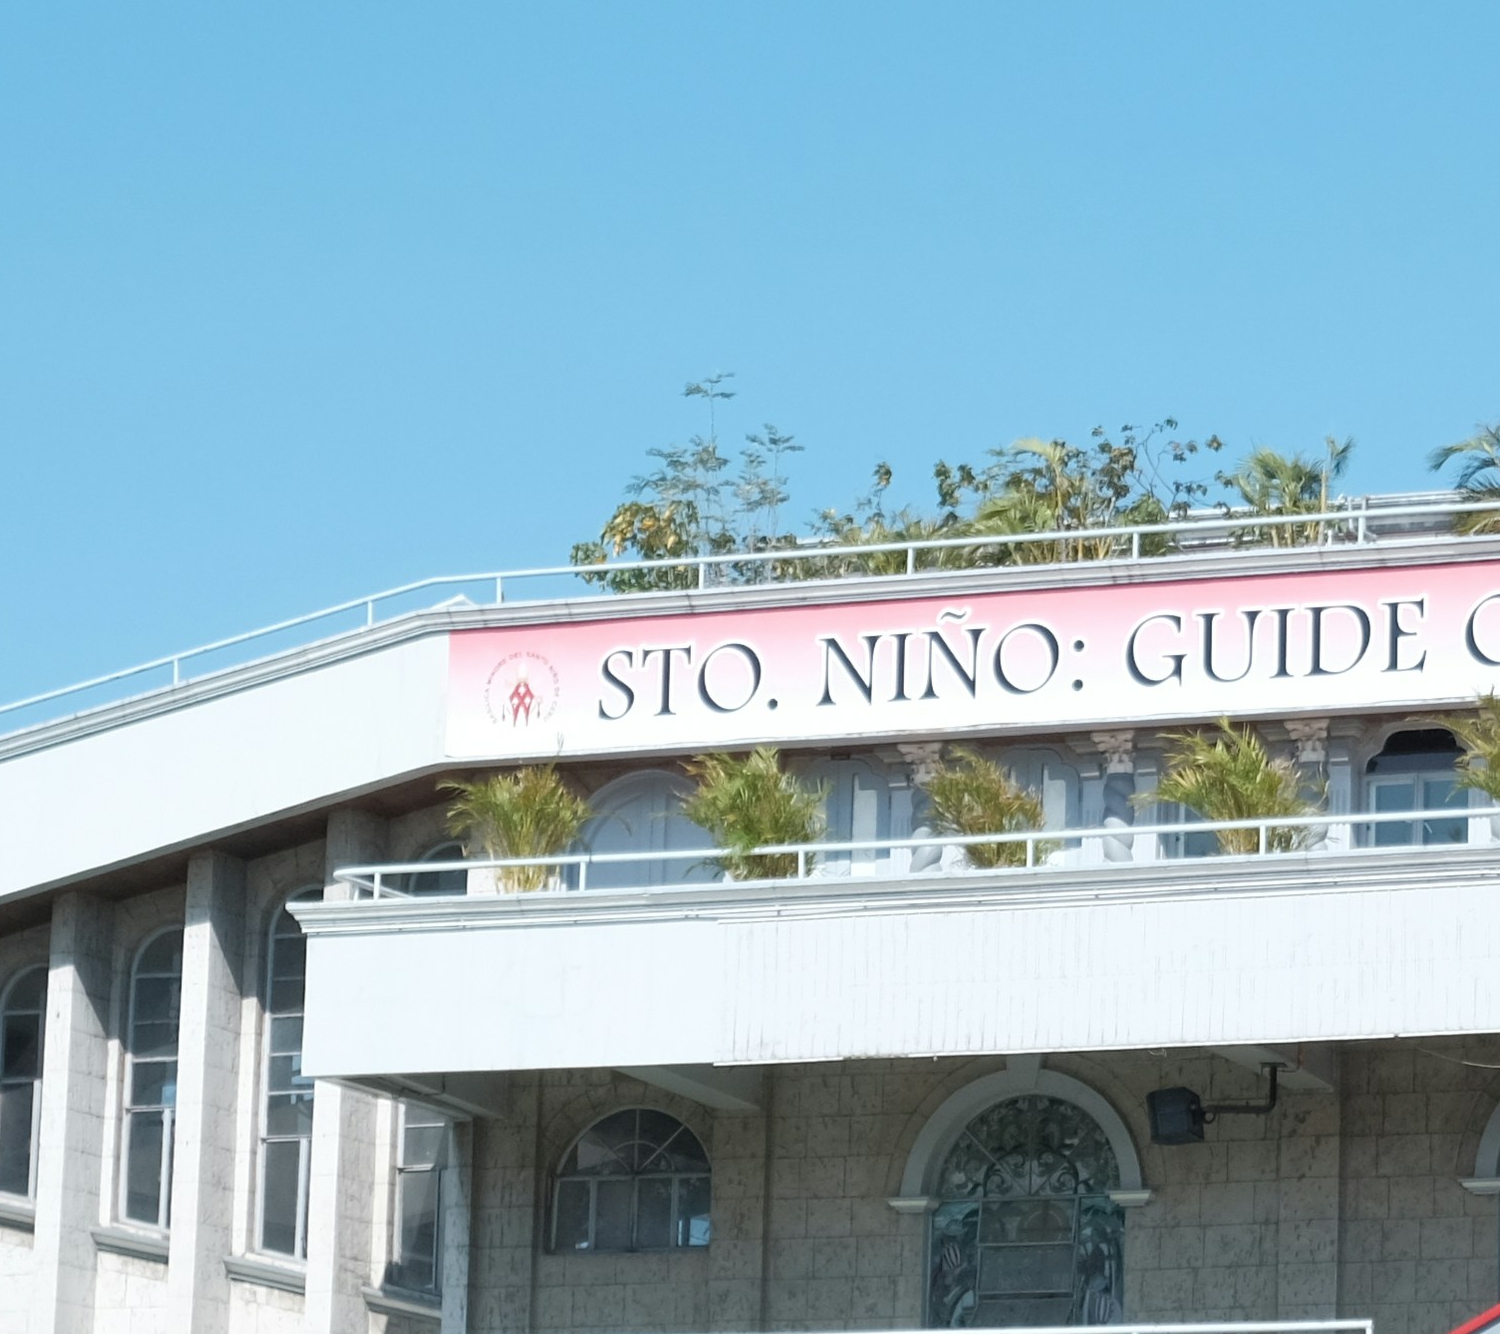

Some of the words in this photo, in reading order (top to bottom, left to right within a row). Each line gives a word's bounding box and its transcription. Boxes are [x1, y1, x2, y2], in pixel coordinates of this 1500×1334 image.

[599, 643, 779, 720] STO.
[816, 610, 1086, 706] NIÑO:
[1125, 598, 1428, 688] GUIDE
